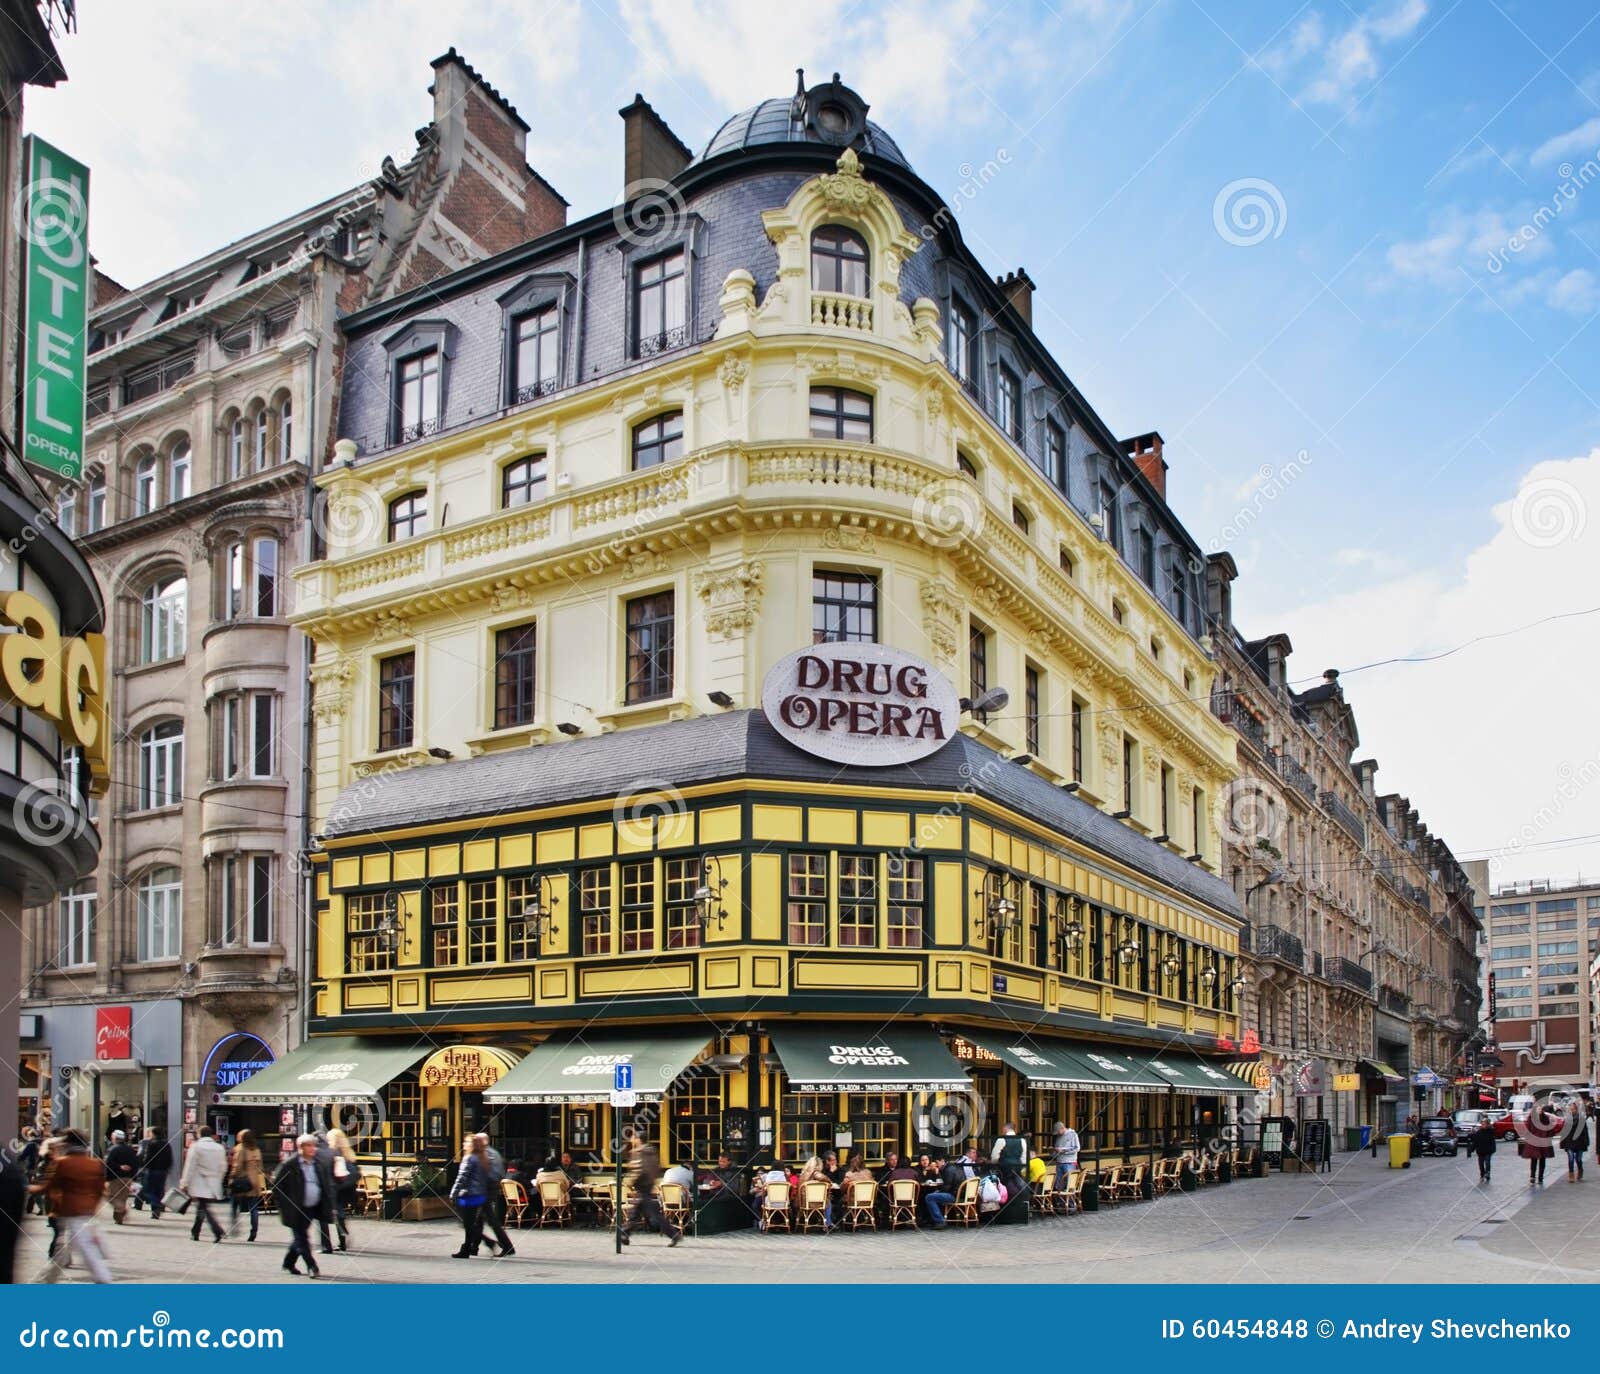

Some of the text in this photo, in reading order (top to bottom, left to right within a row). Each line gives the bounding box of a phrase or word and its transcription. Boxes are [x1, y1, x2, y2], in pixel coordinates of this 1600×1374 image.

[35, 155, 84, 435] HOTEL
[26, 432, 81, 465] OPERA
[797, 655, 928, 699] DRUG
[779, 694, 947, 740] OPERA
[444, 1048, 480, 1067] drug
[576, 1054, 633, 1066] DRUG
[828, 1055, 910, 1066] OPERA
[829, 1045, 895, 1057] DRUG
[216, 1070, 240, 1086] SUN
[425, 1065, 497, 1085] OPERA
[561, 1065, 616, 1076] OPER
